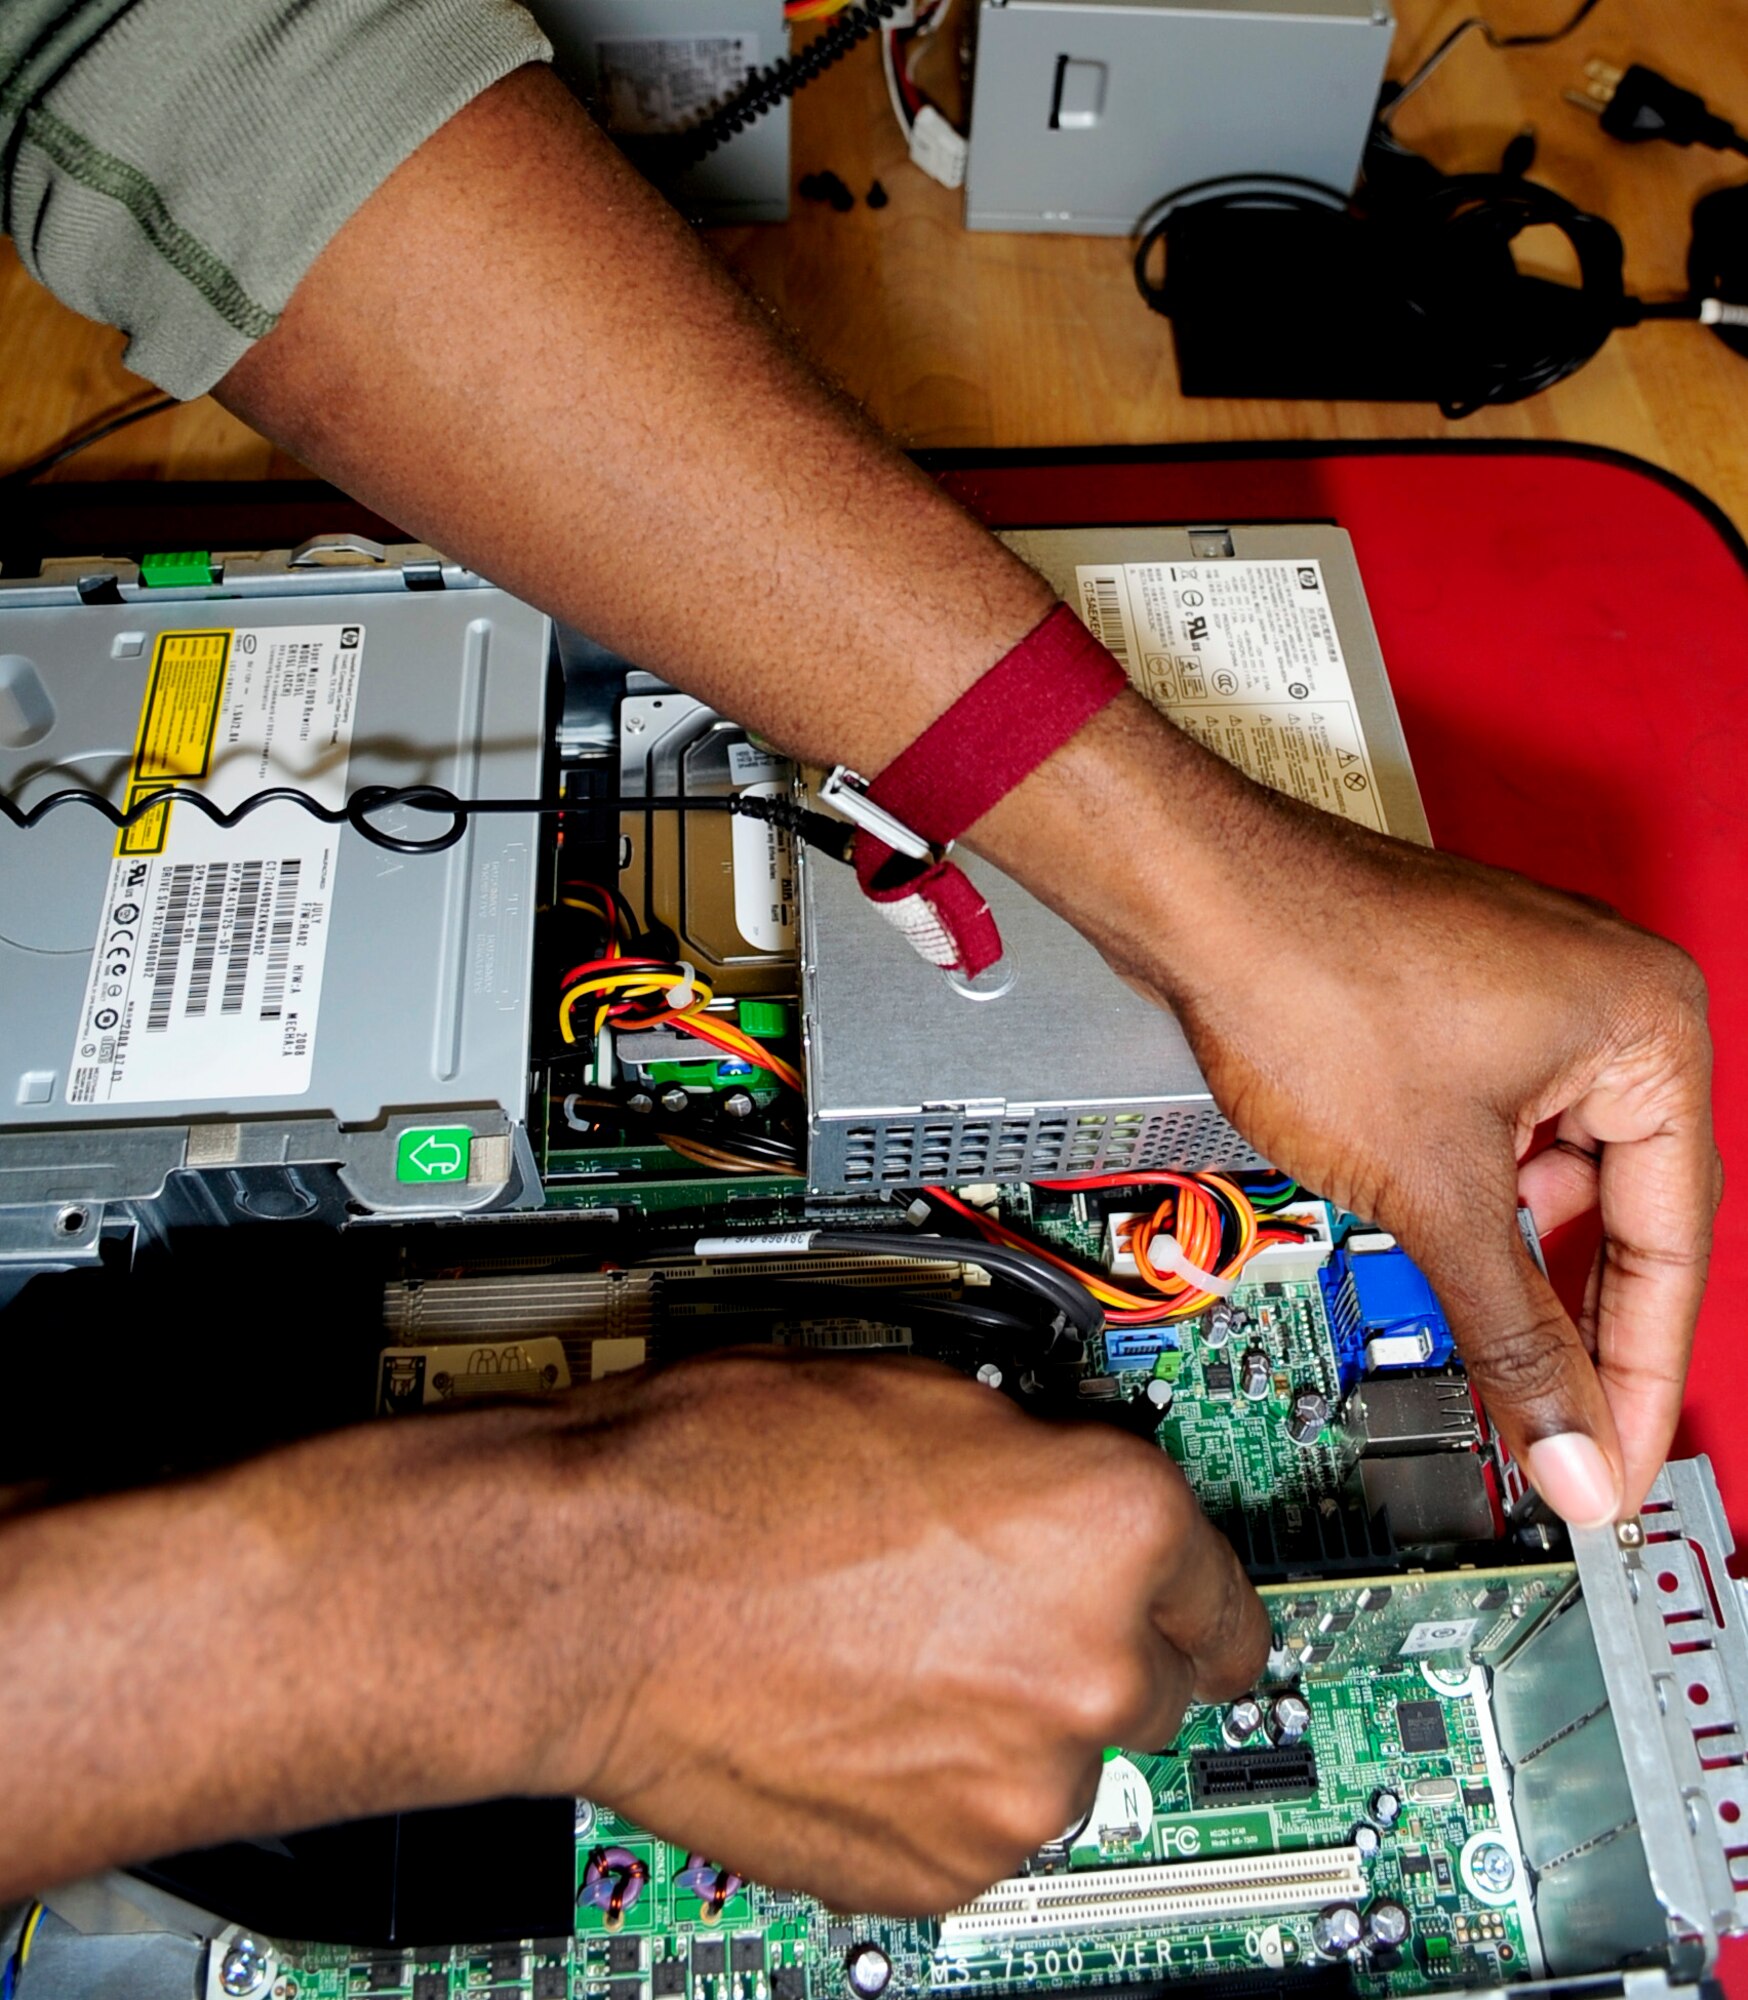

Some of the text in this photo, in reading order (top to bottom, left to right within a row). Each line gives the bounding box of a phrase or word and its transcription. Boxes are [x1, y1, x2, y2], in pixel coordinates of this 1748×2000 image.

[300, 643, 323, 741] Super Multi DVD Rewriter
[158, 866, 174, 893] DRIVE
[231, 862, 243, 874] HP
[311, 902, 324, 924] JULY
[771, 904, 779, 922] RoHS
[282, 902, 312, 1057] F/W:RA02 H/W:A MECHA:A
[294, 1032, 308, 1056] 2008
[1211, 1838, 1229, 1847] Model
[930, 1945, 1083, 1987] MS-7500
